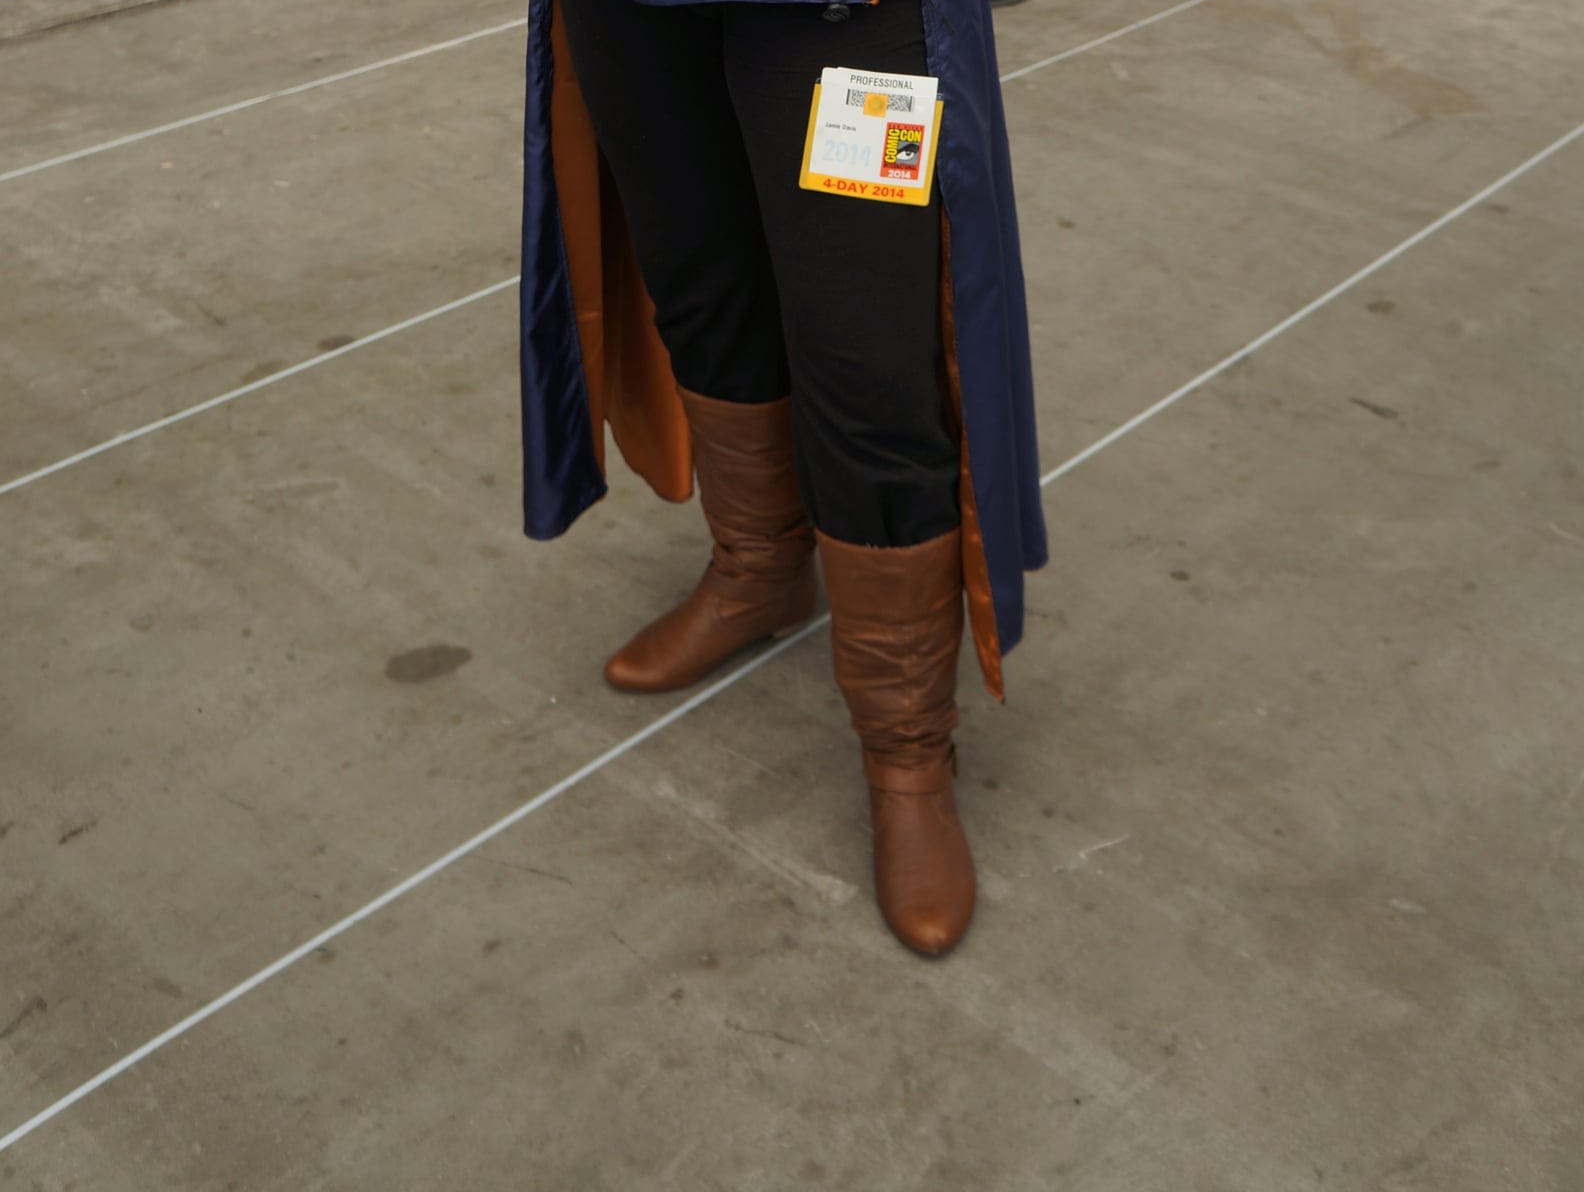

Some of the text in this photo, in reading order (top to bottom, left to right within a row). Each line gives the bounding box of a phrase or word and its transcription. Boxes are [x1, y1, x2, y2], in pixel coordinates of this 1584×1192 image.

[850, 75, 914, 89] PROFESSIONAL
[899, 129, 922, 142] CON
[885, 129, 900, 163] COMIC
[887, 170, 911, 179] 2014
[823, 178, 905, 199] 4-DAY 2014
